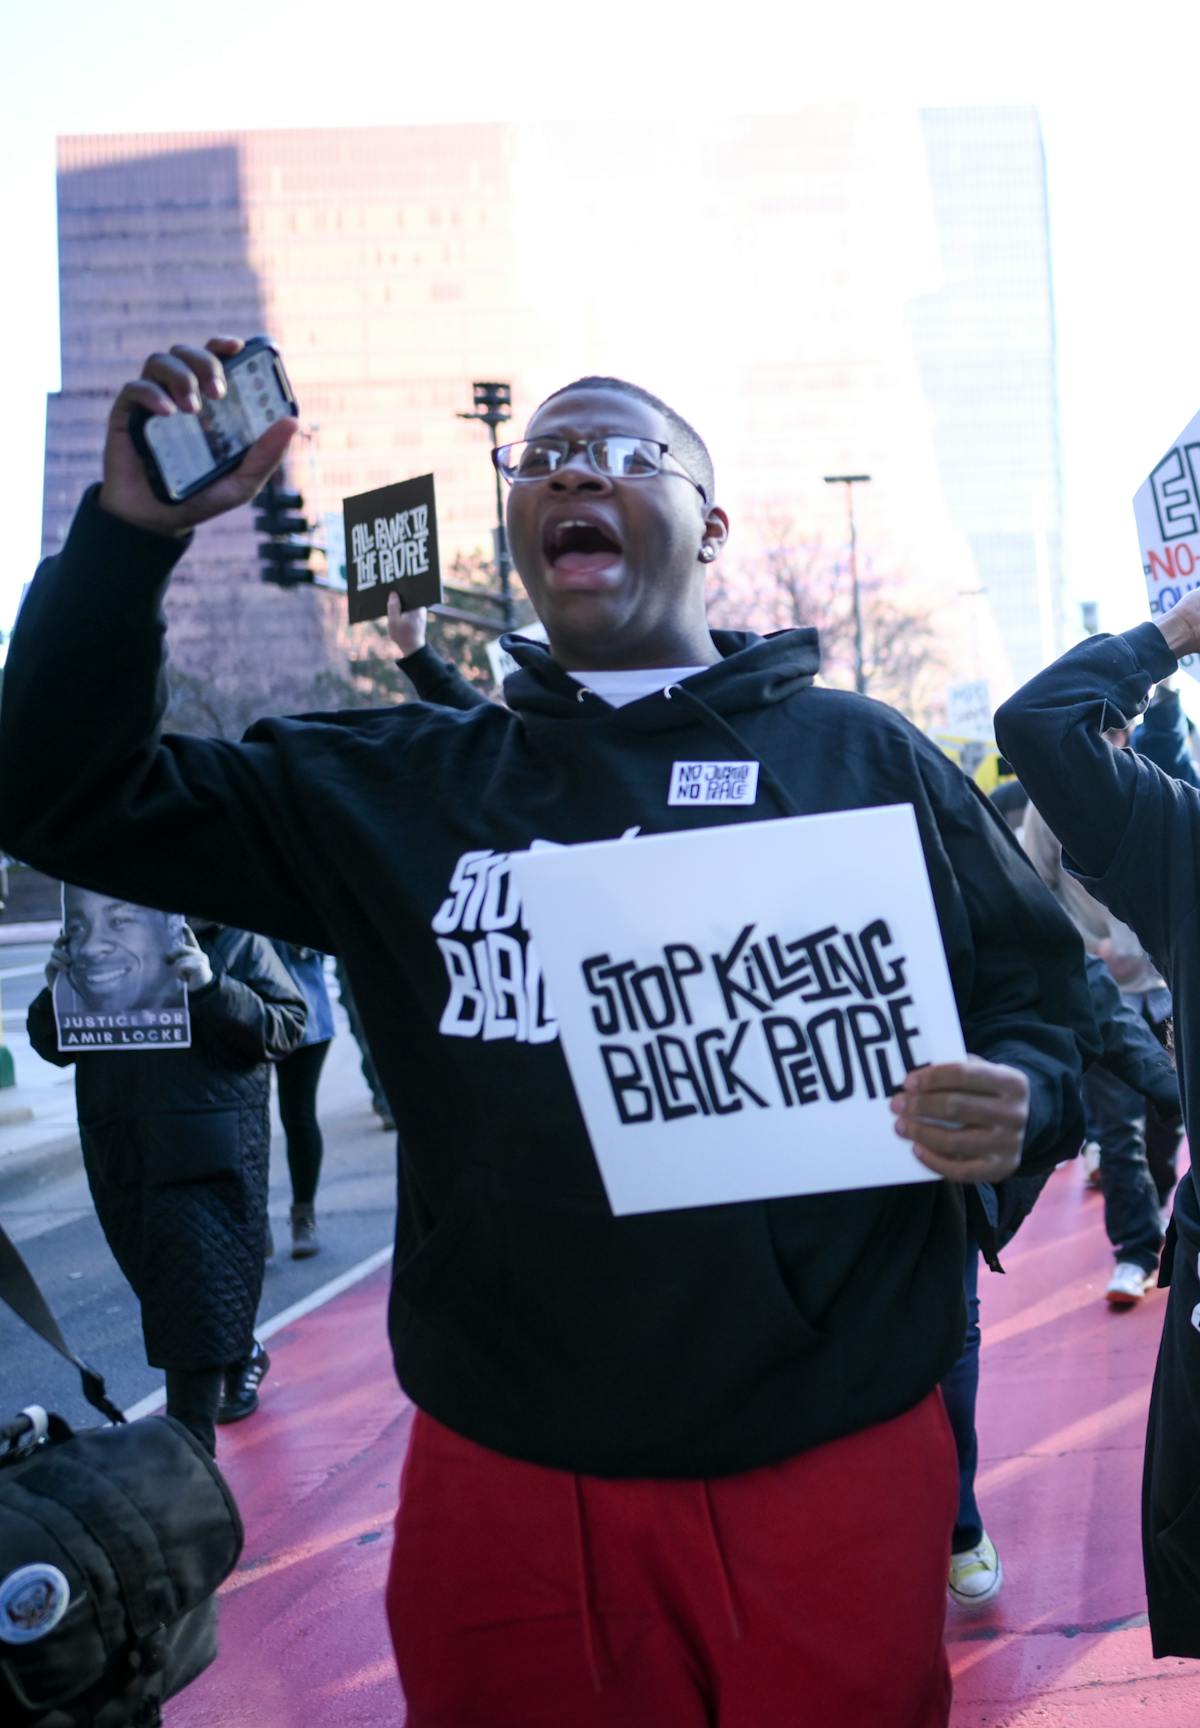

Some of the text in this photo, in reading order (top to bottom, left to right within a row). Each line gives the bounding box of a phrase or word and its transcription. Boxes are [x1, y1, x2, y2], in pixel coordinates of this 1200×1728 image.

[351, 504, 429, 556] ALL POWER TO
[352, 537, 430, 591] THE PEOPLE
[677, 783, 700, 799] NO
[678, 764, 702, 782] NO
[431, 846, 548, 934] STO
[436, 931, 559, 1045] BLAC
[581, 943, 704, 1036] STOP
[64, 1011, 184, 1029] JUSTICE FOR
[68, 1028, 182, 1044] AMIR LOCKE
[599, 995, 932, 1125] BLACK PEOPLE
